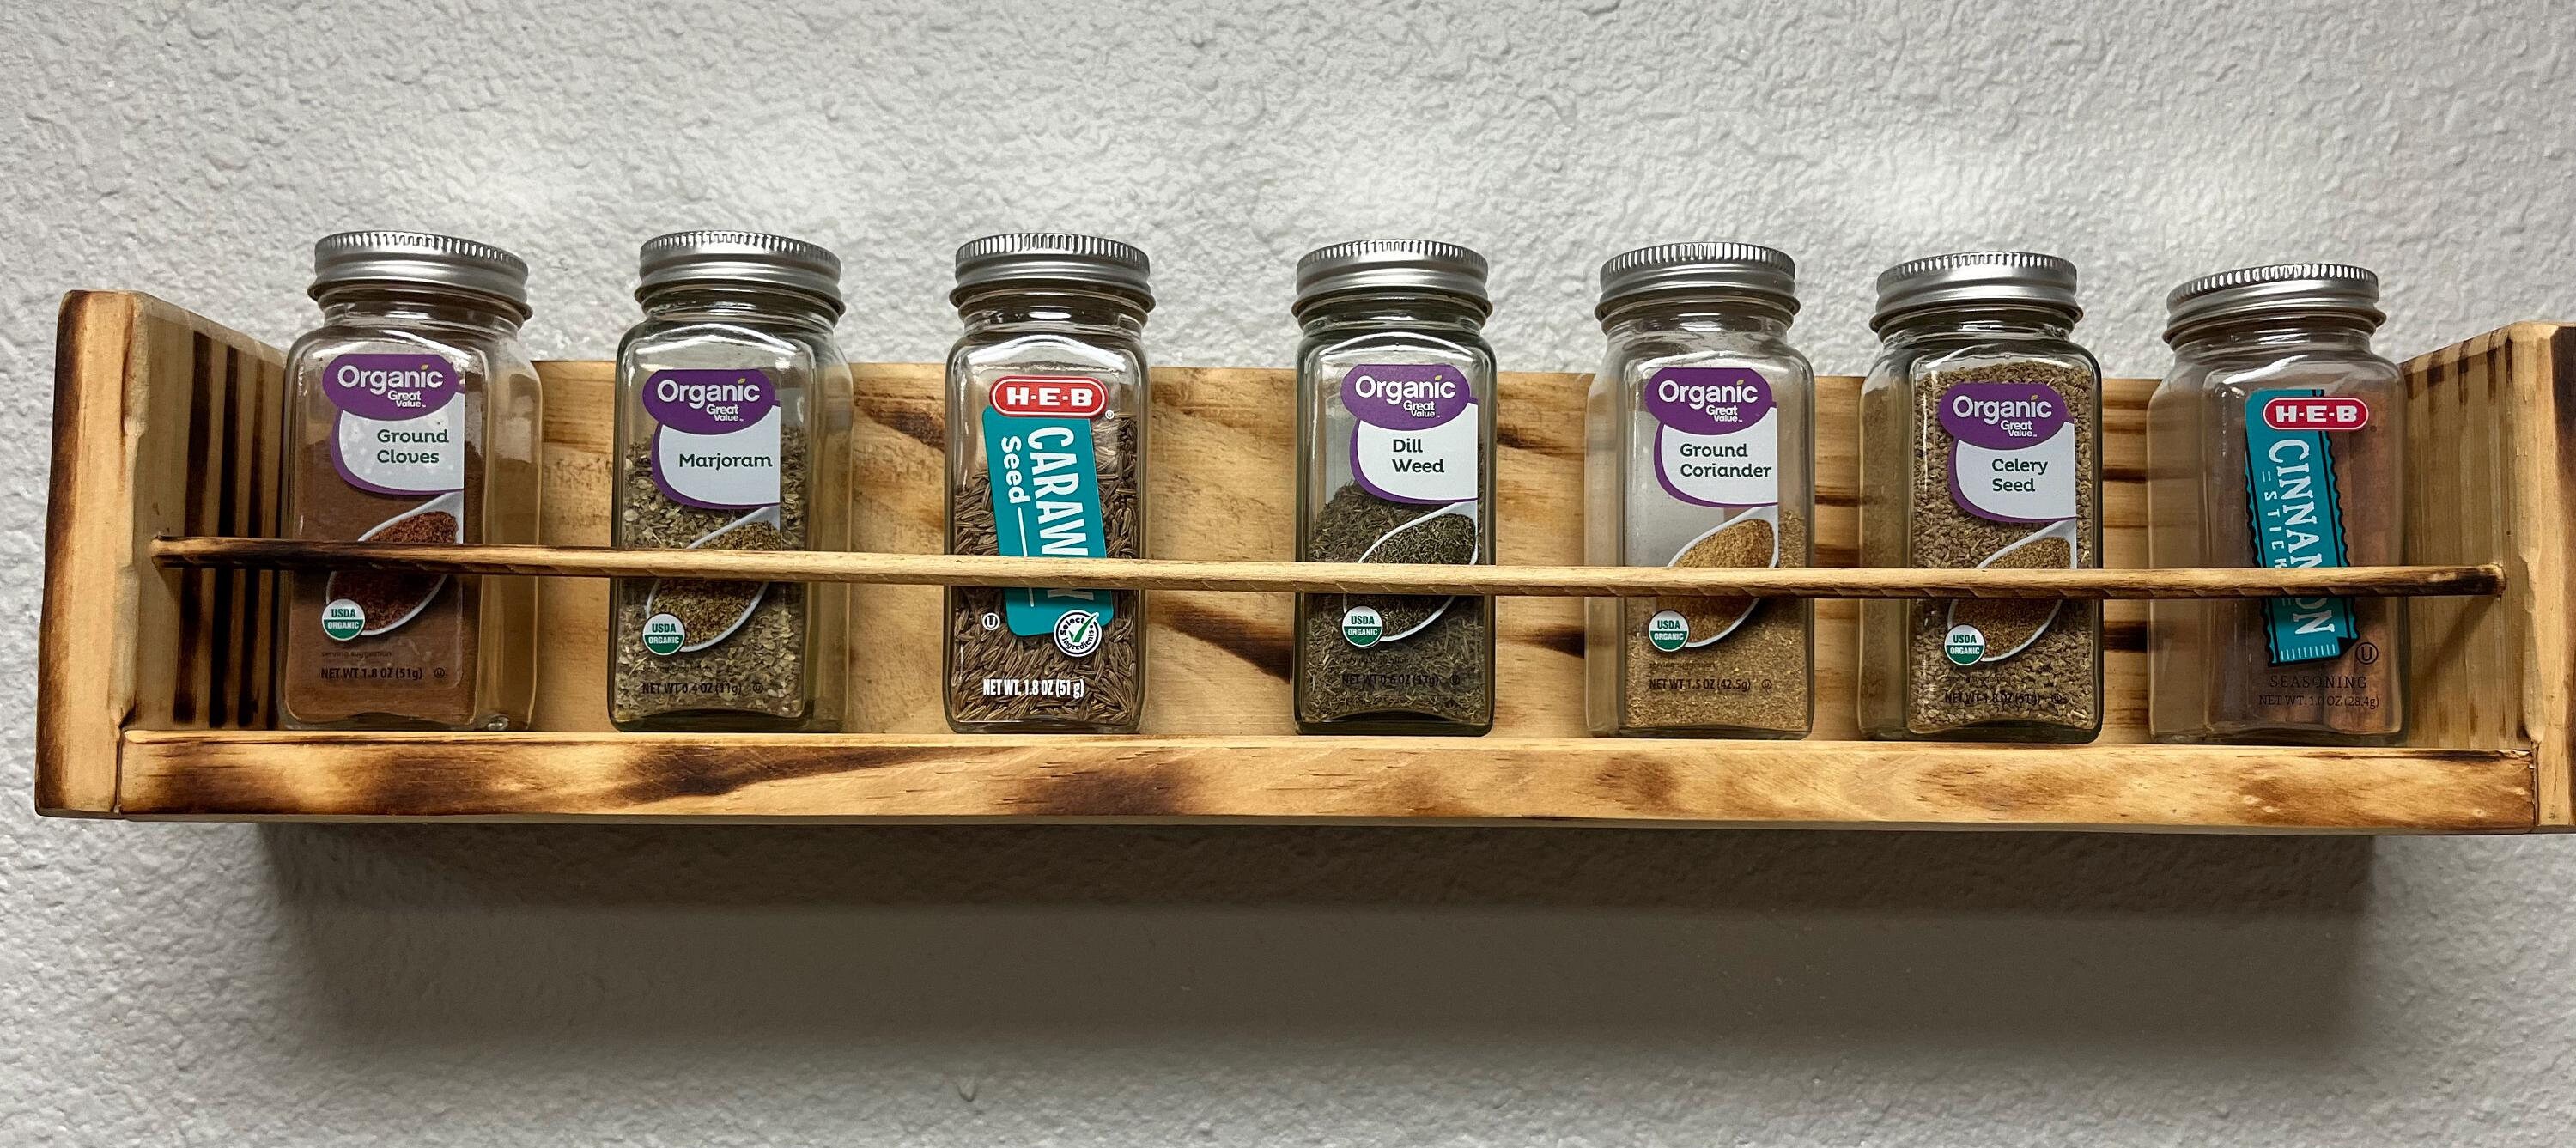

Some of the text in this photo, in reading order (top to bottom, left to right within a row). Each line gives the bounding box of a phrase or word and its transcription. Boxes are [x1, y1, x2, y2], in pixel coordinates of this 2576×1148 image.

[338, 365, 443, 395] Organic
[388, 390, 421, 401] Great
[658, 379, 760, 409] Organic
[1356, 375, 1455, 405] Organic
[1658, 380, 1758, 410] Organic
[706, 404, 738, 416] Great
[1403, 400, 1435, 411] Great
[1706, 404, 1737, 416] Great
[1953, 395, 2051, 425] Organic
[2000, 420, 2032, 431] Great
[377, 429, 449, 443] Ground
[1393, 439, 1423, 453] Dill
[1680, 443, 1748, 458] Ground
[377, 450, 439, 464] Cloves
[679, 453, 773, 471] Marjoram
[1001, 435, 1031, 504] Seed
[1392, 459, 1444, 472] Weed
[1680, 464, 1771, 477] Coriander
[1992, 459, 2048, 475] Celery
[1992, 478, 2035, 492] Seed
[1028, 427, 1095, 600] CARAW
[331, 609, 355, 618] USDA
[1351, 616, 1375, 625] USDA
[328, 621, 359, 629] ORGANIC
[652, 623, 676, 633] USDA
[1062, 620, 1091, 642] Select
[1657, 620, 1680, 629] USDA
[1348, 628, 1377, 636] ORGANIC
[1953, 635, 1977, 643] USDA
[1064, 635, 1103, 659] Ingredients
[321, 667, 422, 681] NET WT 1.8 OZ (51g)
[1342, 674, 1360, 684] NET
[1363, 674, 1378, 684] WT
[1398, 674, 1411, 684] OZ
[642, 683, 661, 695] NET
[664, 683, 681, 695] WT
[682, 683, 698, 695] 0.4
[700, 683, 714, 695] OZ
[983, 679, 1001, 695] NET
[1003, 679, 1022, 695] WT.
[1024, 679, 1039, 695] 1.8
[1041, 679, 1054, 695] OZ
[1649, 678, 1751, 692] NET WT 1.5 OZ (42.5g)
[2270, 676, 2367, 689] SEASONING
[1945, 692, 1962, 702] NET
[2258, 695, 2282, 707] NET
[2284, 695, 2307, 707] WT.
[2344, 695, 2379, 710] (28.4g)
